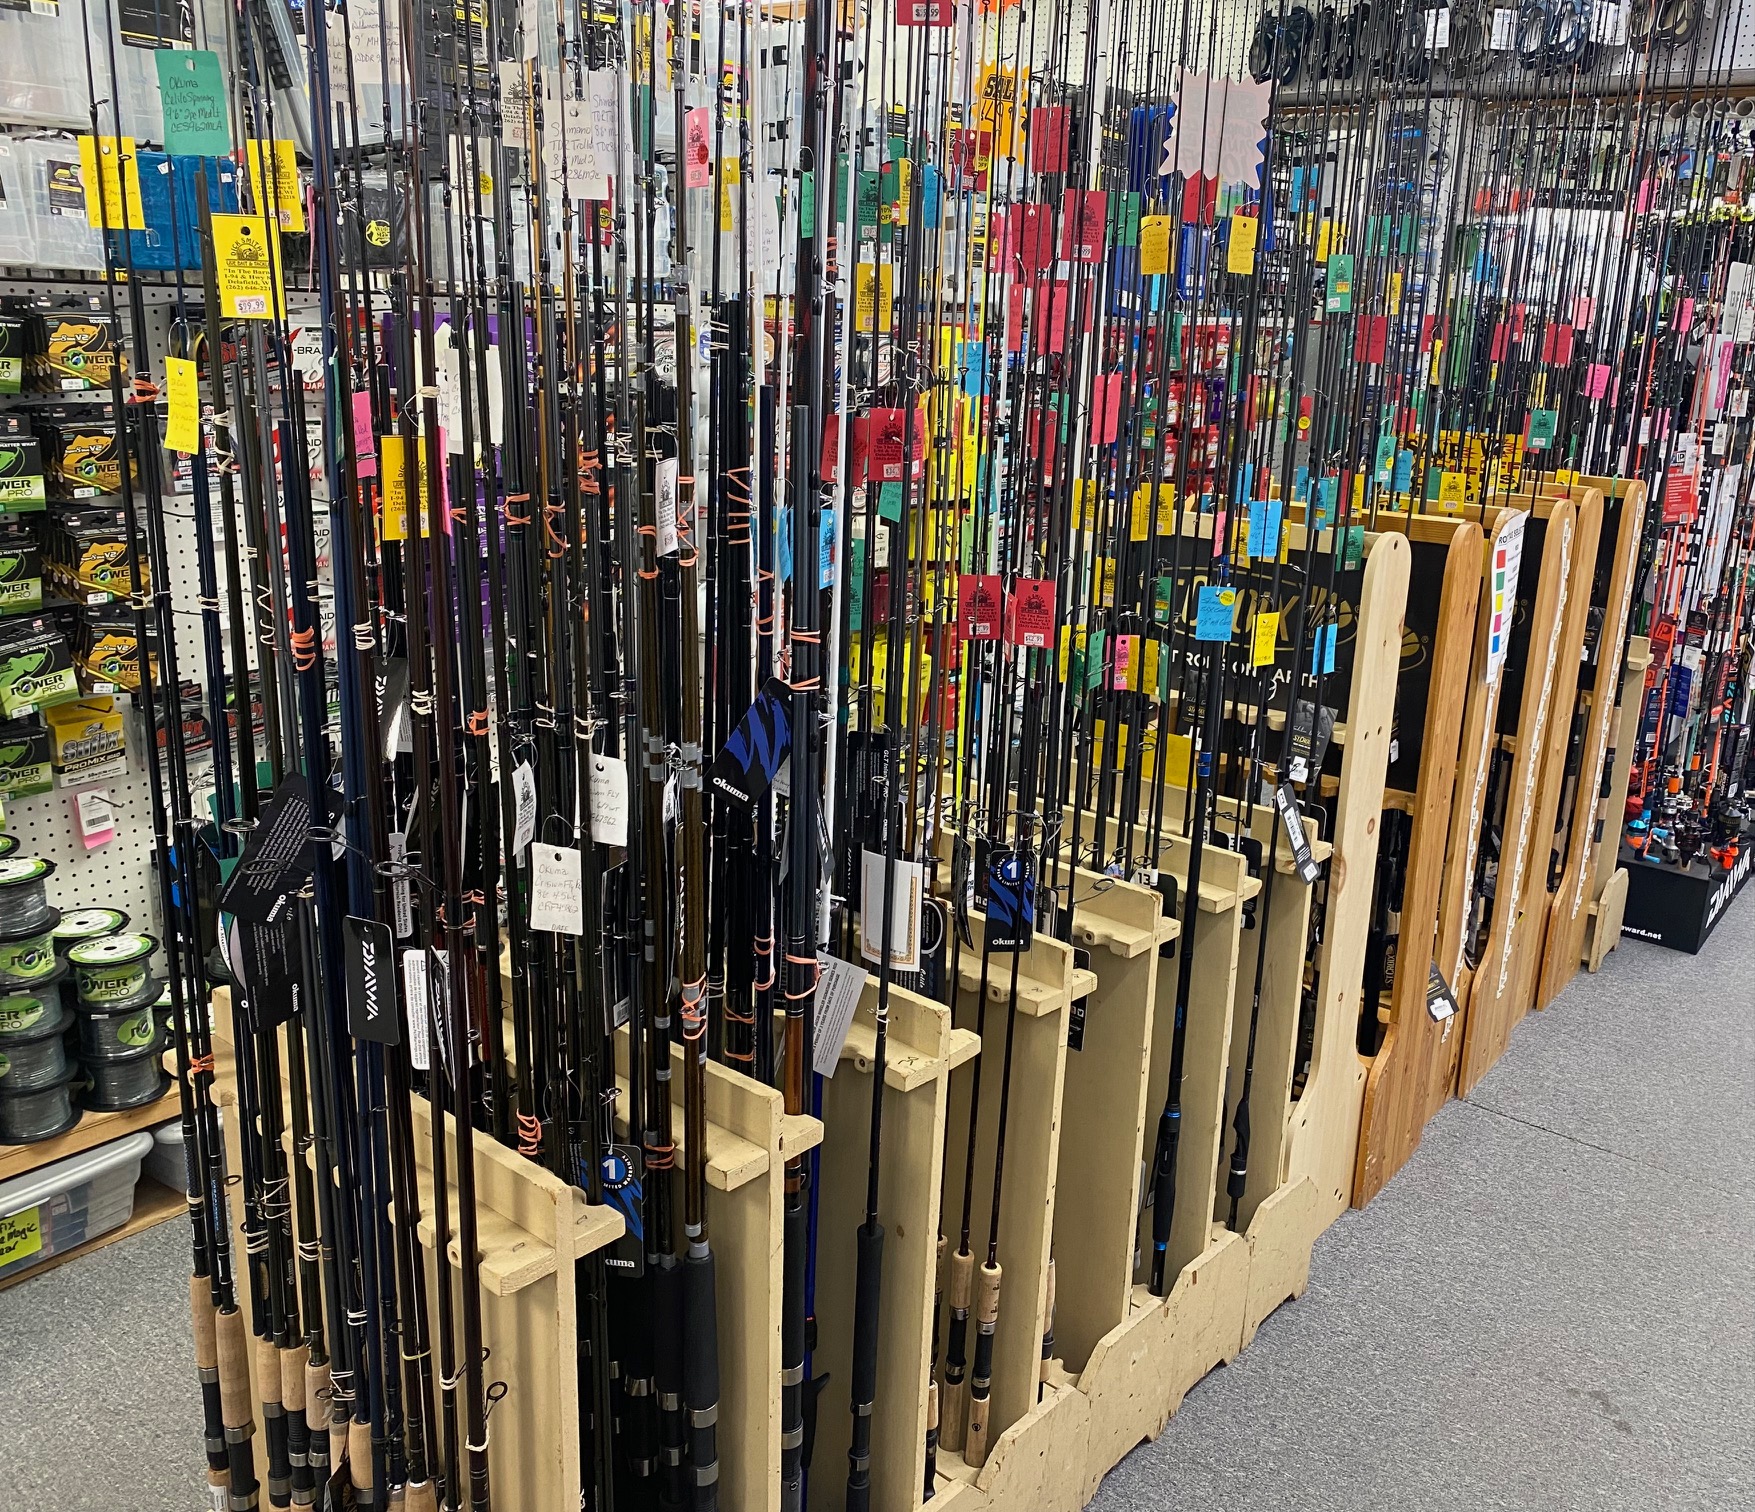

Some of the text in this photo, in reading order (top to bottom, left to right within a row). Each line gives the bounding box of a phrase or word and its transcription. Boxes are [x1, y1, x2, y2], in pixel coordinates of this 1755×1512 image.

[594, 94, 618, 108] Shiman
[551, 122, 592, 137] Simano
[230, 238, 265, 258] DICK SMITH'S
[238, 300, 265, 311] $99.99
[294, 346, 322, 354] -BRA
[61, 352, 114, 368] POWER
[0, 480, 31, 489] WER
[8, 489, 33, 497] PRO
[90, 568, 130, 582] POWE
[0, 582, 30, 594] WER
[8, 591, 31, 600] PRO
[29, 643, 48, 651] MATTER
[99, 662, 139, 675] POWE
[11, 675, 63, 697] POWER
[42, 684, 66, 695] PRO
[62, 730, 120, 762] Sufix
[18, 776, 41, 784] PRO
[713, 777, 750, 802] okuma
[1006, 862, 1018, 878] 1
[1138, 872, 1151, 886] 13
[1705, 846, 1751, 928] DAIWA
[266, 894, 287, 922] okuma
[362, 940, 379, 1021] DAIWA
[100, 988, 130, 998] PRO
[291, 983, 300, 1012] okuma
[602, 1158, 616, 1180] 1
[7, 1223, 37, 1241] Magic
